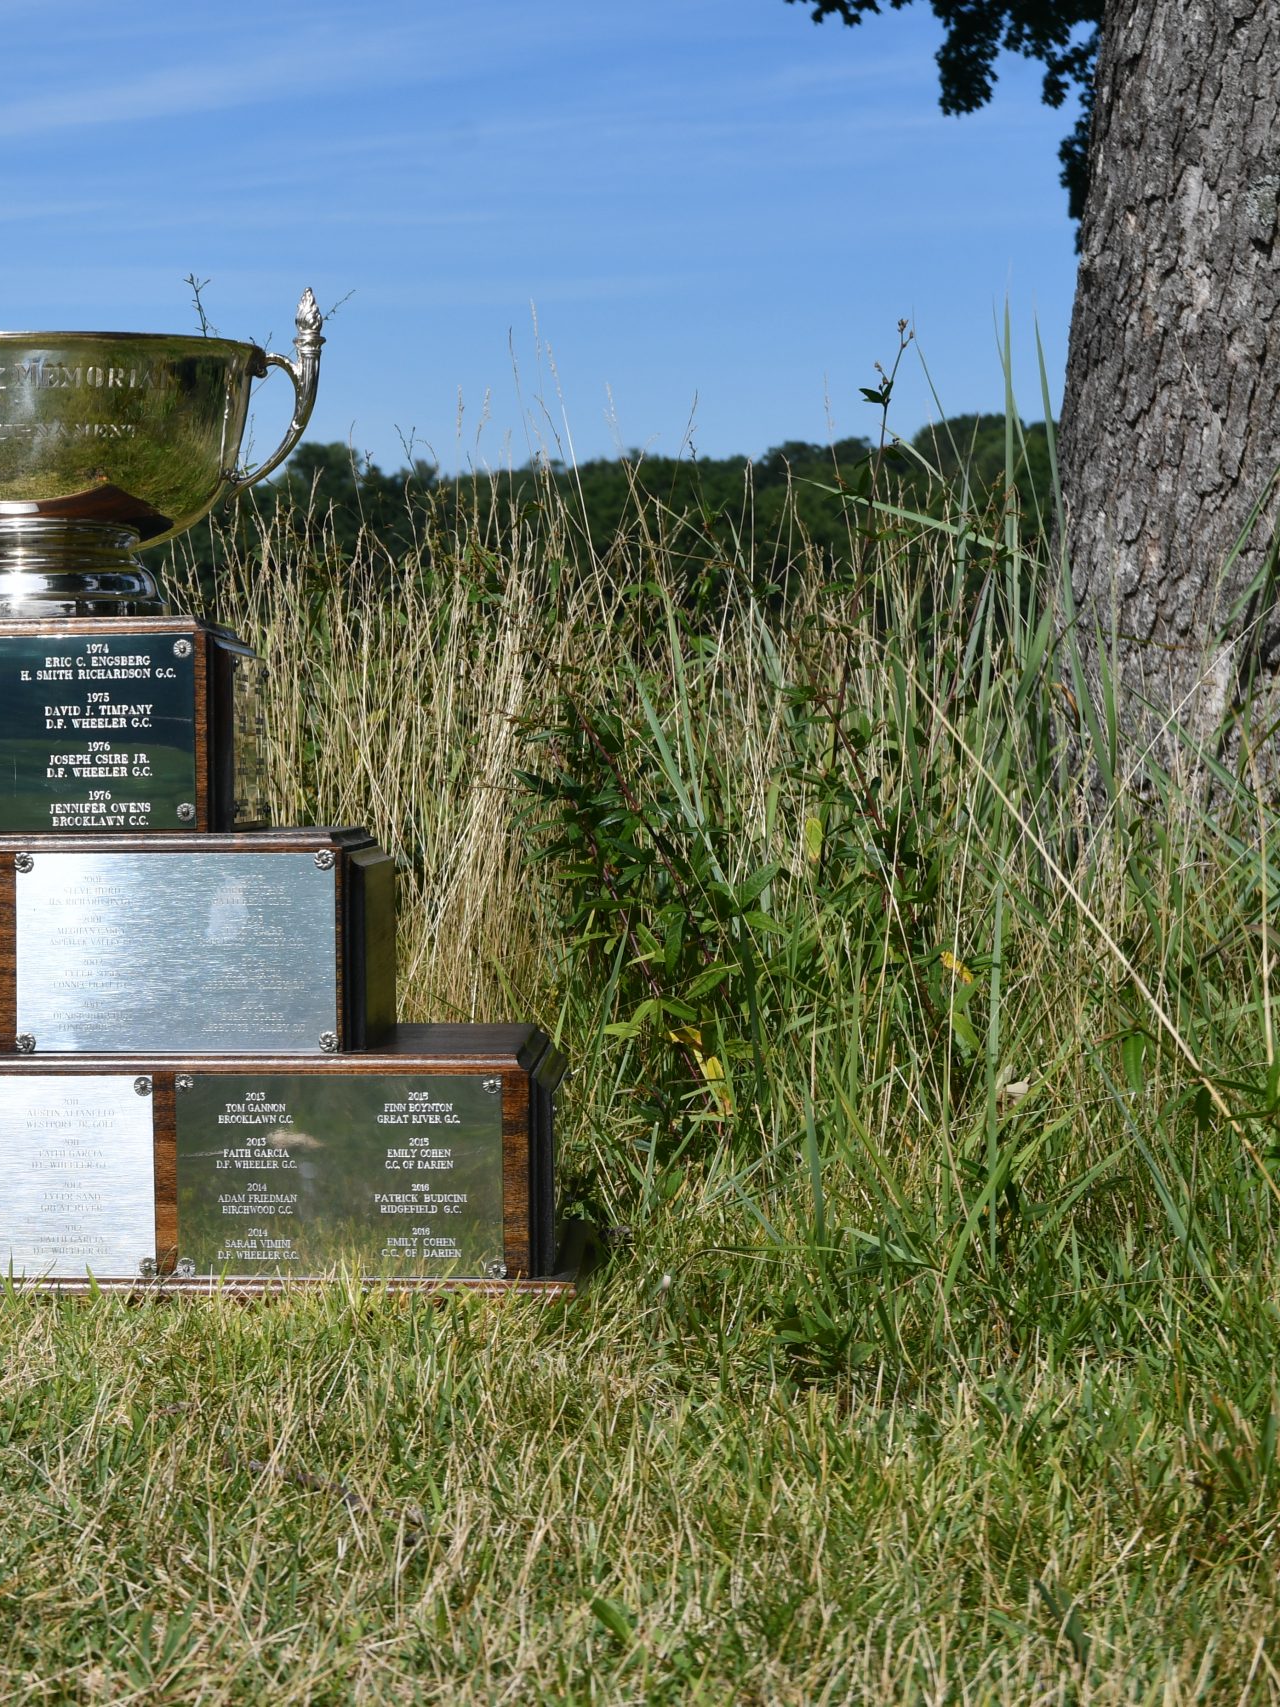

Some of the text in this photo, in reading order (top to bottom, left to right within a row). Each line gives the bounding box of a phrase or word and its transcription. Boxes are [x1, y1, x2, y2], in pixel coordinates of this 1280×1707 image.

[86, 644, 109, 654] 1974
[45, 656, 150, 667] ERIC C. ENGSBERG
[21, 668, 176, 681] H. SMITH RICHARDSON G.C.
[87, 692, 109, 702] 1975
[45, 705, 152, 716] DAVID J. TIMPANY
[46, 718, 152, 729] D.F. WHEELER G.C.
[88, 742, 110, 751] 1976
[50, 754, 150, 765] JOSEPH CSIRE JR.
[47, 767, 152, 778] D.F. WHEELER G.C.
[89, 791, 111, 800] 1976
[50, 802, 150, 813] JENNIFER OWENS
[52, 816, 148, 826] BROOKLAWN C.C.
[246, 1092, 265, 1101] 2013
[408, 1092, 428, 1101] 2015
[226, 1104, 286, 1112] TOM GANNON
[384, 1103, 453, 1112] FINN BOYNTON
[218, 1115, 276, 1123] BROOKLAWN
[377, 1115, 409, 1123] GREAT
[412, 1115, 442, 1123] RIVER
[246, 1138, 266, 1146] 2013
[409, 1138, 429, 1146] 2015
[223, 1149, 289, 1157] FAITH GARCIA
[387, 1149, 451, 1158] EMILY COHEN
[234, 1160, 279, 1168] WHEELER
[402, 1160, 414, 1169] OF
[417, 1160, 453, 1169] DARIEN
[247, 1183, 267, 1191] 2014
[218, 1194, 298, 1202] ADAM FRIEDMAN
[374, 1194, 467, 1202] PATRICK BUDICINI
[222, 1206, 275, 1214] BIRCHWOOD
[381, 1205, 438, 1213] RIDGEFIELD
[248, 1228, 268, 1237] 2014
[225, 1240, 257, 1248] SARAH
[387, 1238, 456, 1246] EMILY COHEN
[237, 1251, 280, 1260] WHEELER
[406, 1249, 417, 1257] OF
[423, 1249, 461, 1257] DARIEN
